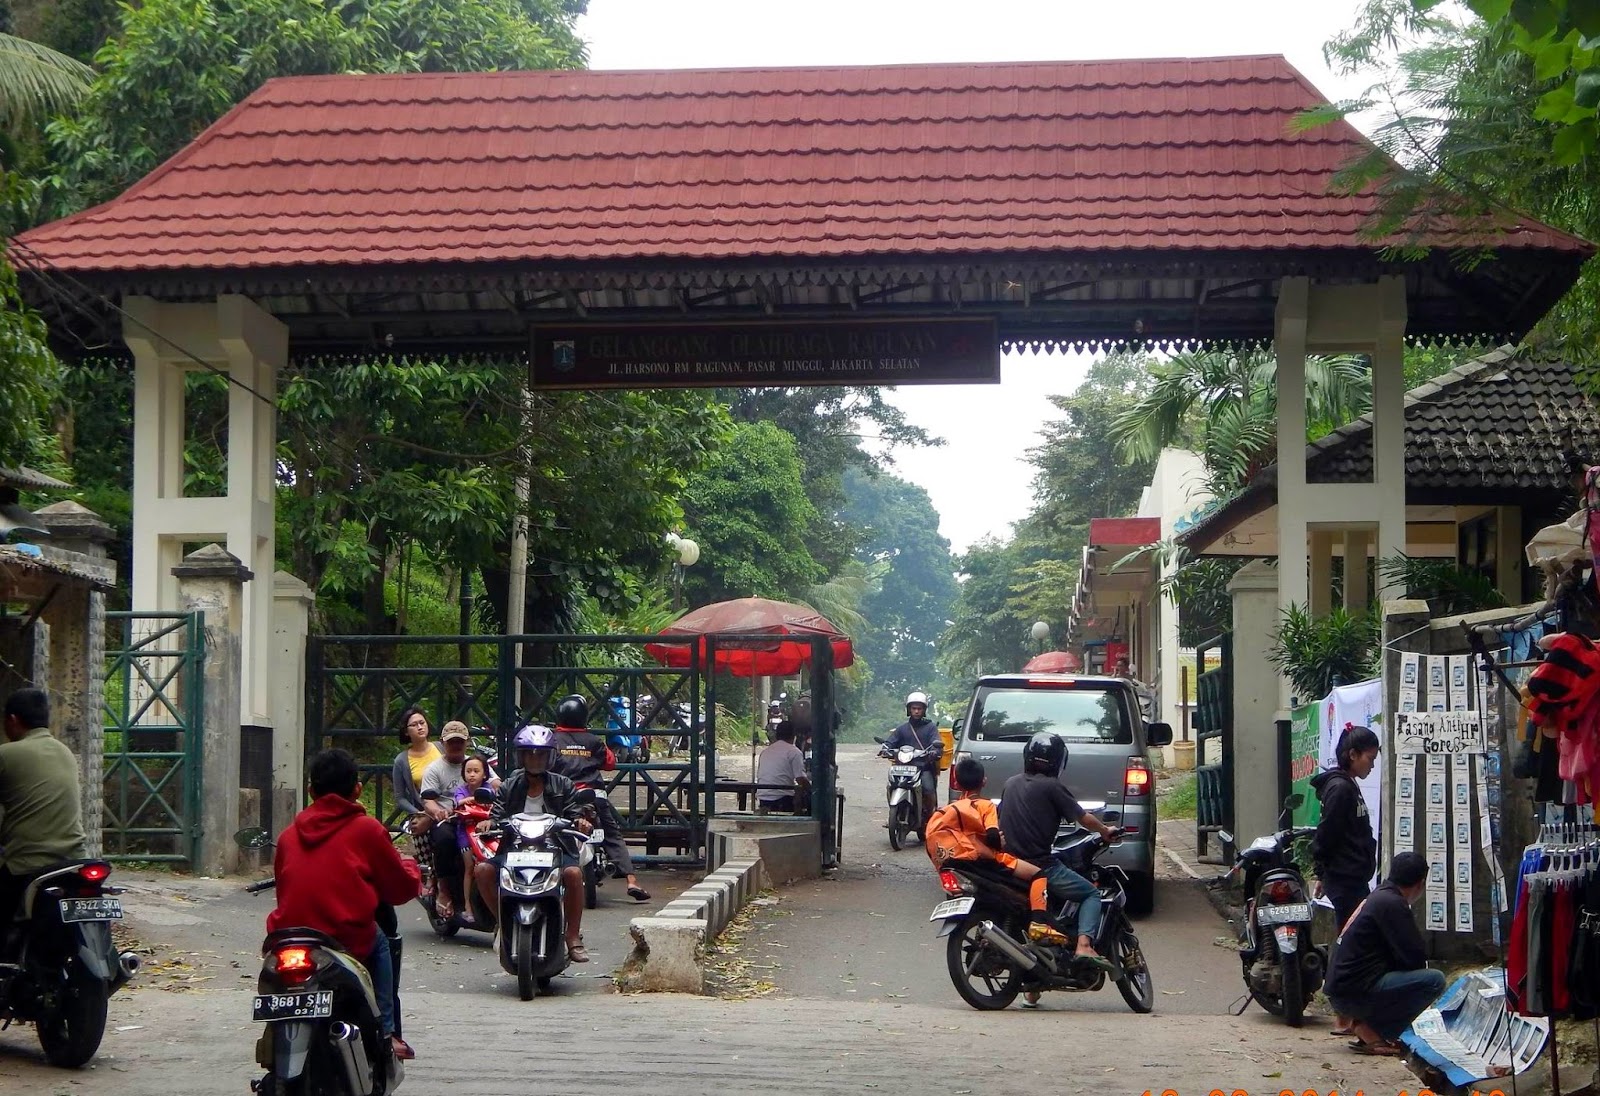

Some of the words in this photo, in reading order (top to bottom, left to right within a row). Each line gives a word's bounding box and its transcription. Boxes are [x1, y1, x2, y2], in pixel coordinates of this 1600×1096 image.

[589, 335, 716, 358] GELANGGANG
[731, 332, 834, 356] OLAHRAGA
[847, 330, 937, 354] RAGUNAN
[674, 362, 689, 373] RM
[748, 361, 776, 372] PASAR
[830, 359, 873, 371] JAKARTA
[879, 358, 920, 371] SELATAN
[1397, 715, 1435, 741] Pasang
[1461, 722, 1479, 739] HP
[1423, 736, 1461, 753] Gores
[62, 902, 69, 911] B
[1259, 909, 1265, 917] B
[255, 999, 262, 1009] B
